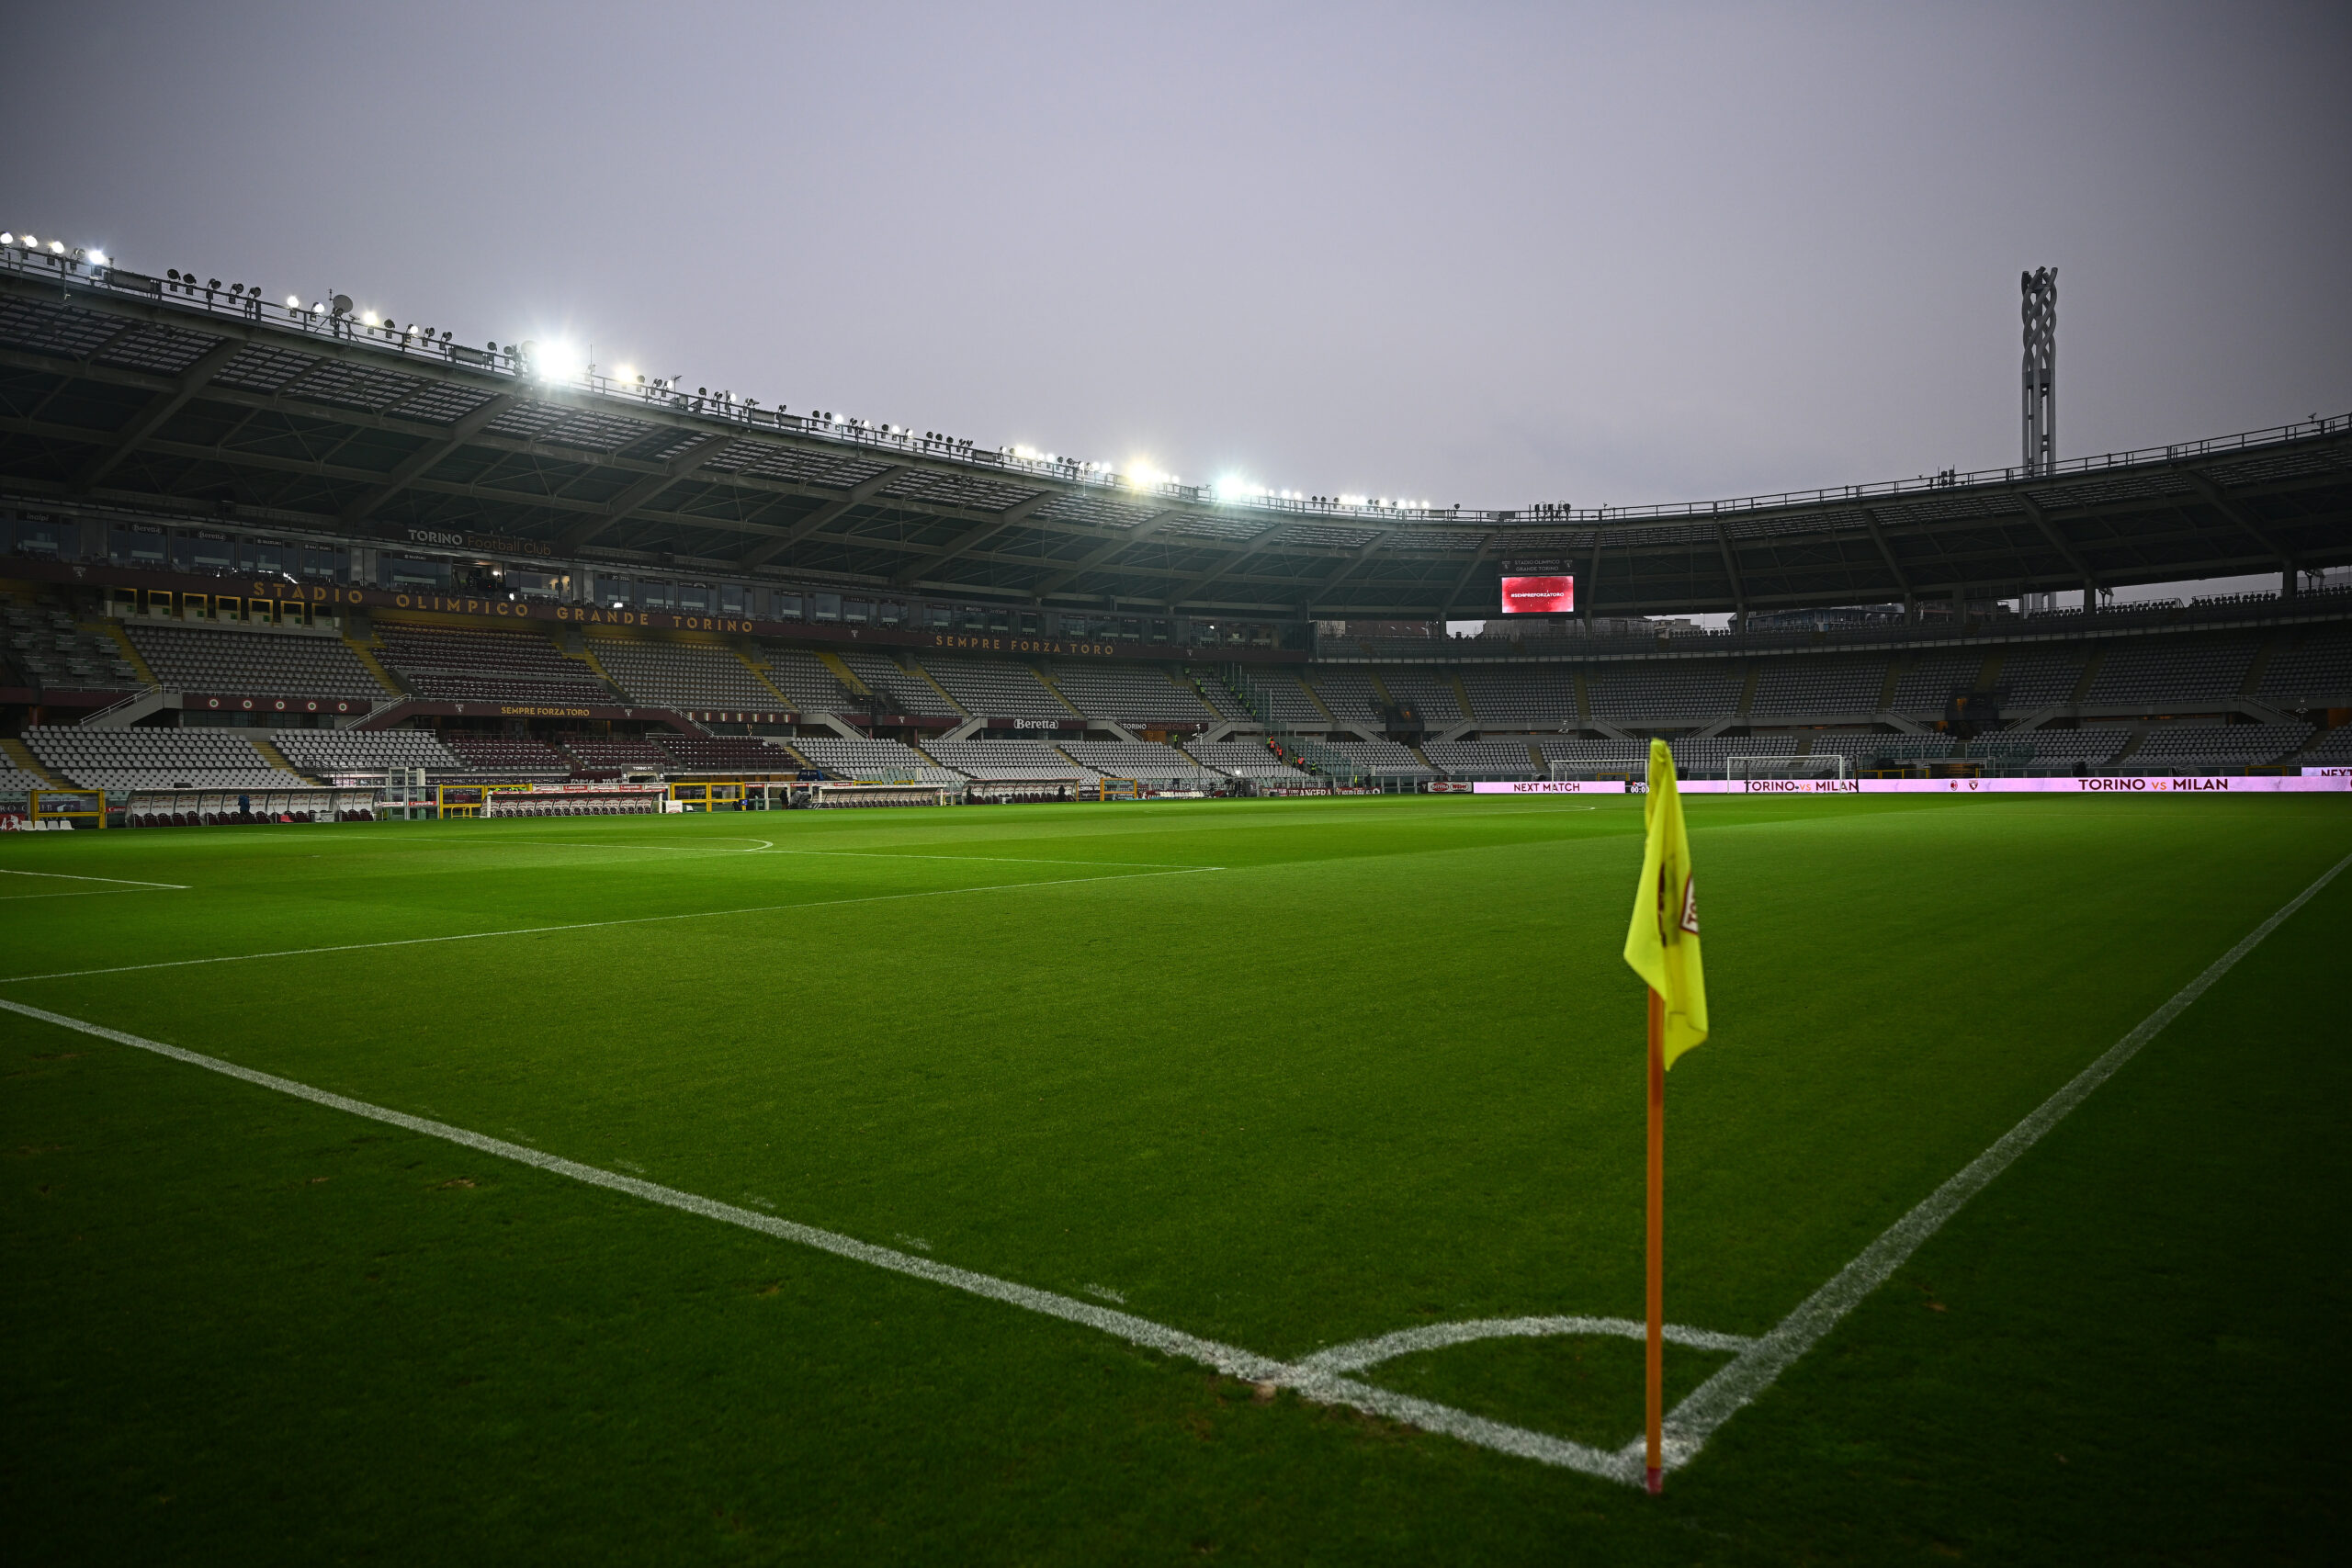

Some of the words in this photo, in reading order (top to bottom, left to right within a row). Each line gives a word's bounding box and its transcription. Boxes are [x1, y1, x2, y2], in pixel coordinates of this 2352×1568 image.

[408, 529, 462, 545] TORINO
[468, 536, 520, 552] Football
[524, 542, 551, 556] Club
[254, 581, 363, 604] STADIO
[396, 594, 527, 616] OLIMPICO
[557, 607, 649, 626] GRANDE
[673, 615, 753, 633] TORINO
[935, 636, 1001, 649] SEMPRE
[1012, 640, 1060, 653] FORZA
[1070, 644, 1114, 655] TORO
[501, 706, 535, 715] SEMPRE
[537, 707, 564, 716] FORZA
[566, 708, 590, 716] TORO
[1013, 718, 1058, 729] Beretta
[1513, 783, 1540, 792] NEXT
[1543, 783, 1580, 792] MATCH
[1744, 781, 1795, 792] TORINO
[1815, 781, 1858, 792] MILAN
[2078, 778, 2146, 791] TORINO
[2152, 781, 2167, 790] vs
[2173, 778, 2228, 791] MILAN
